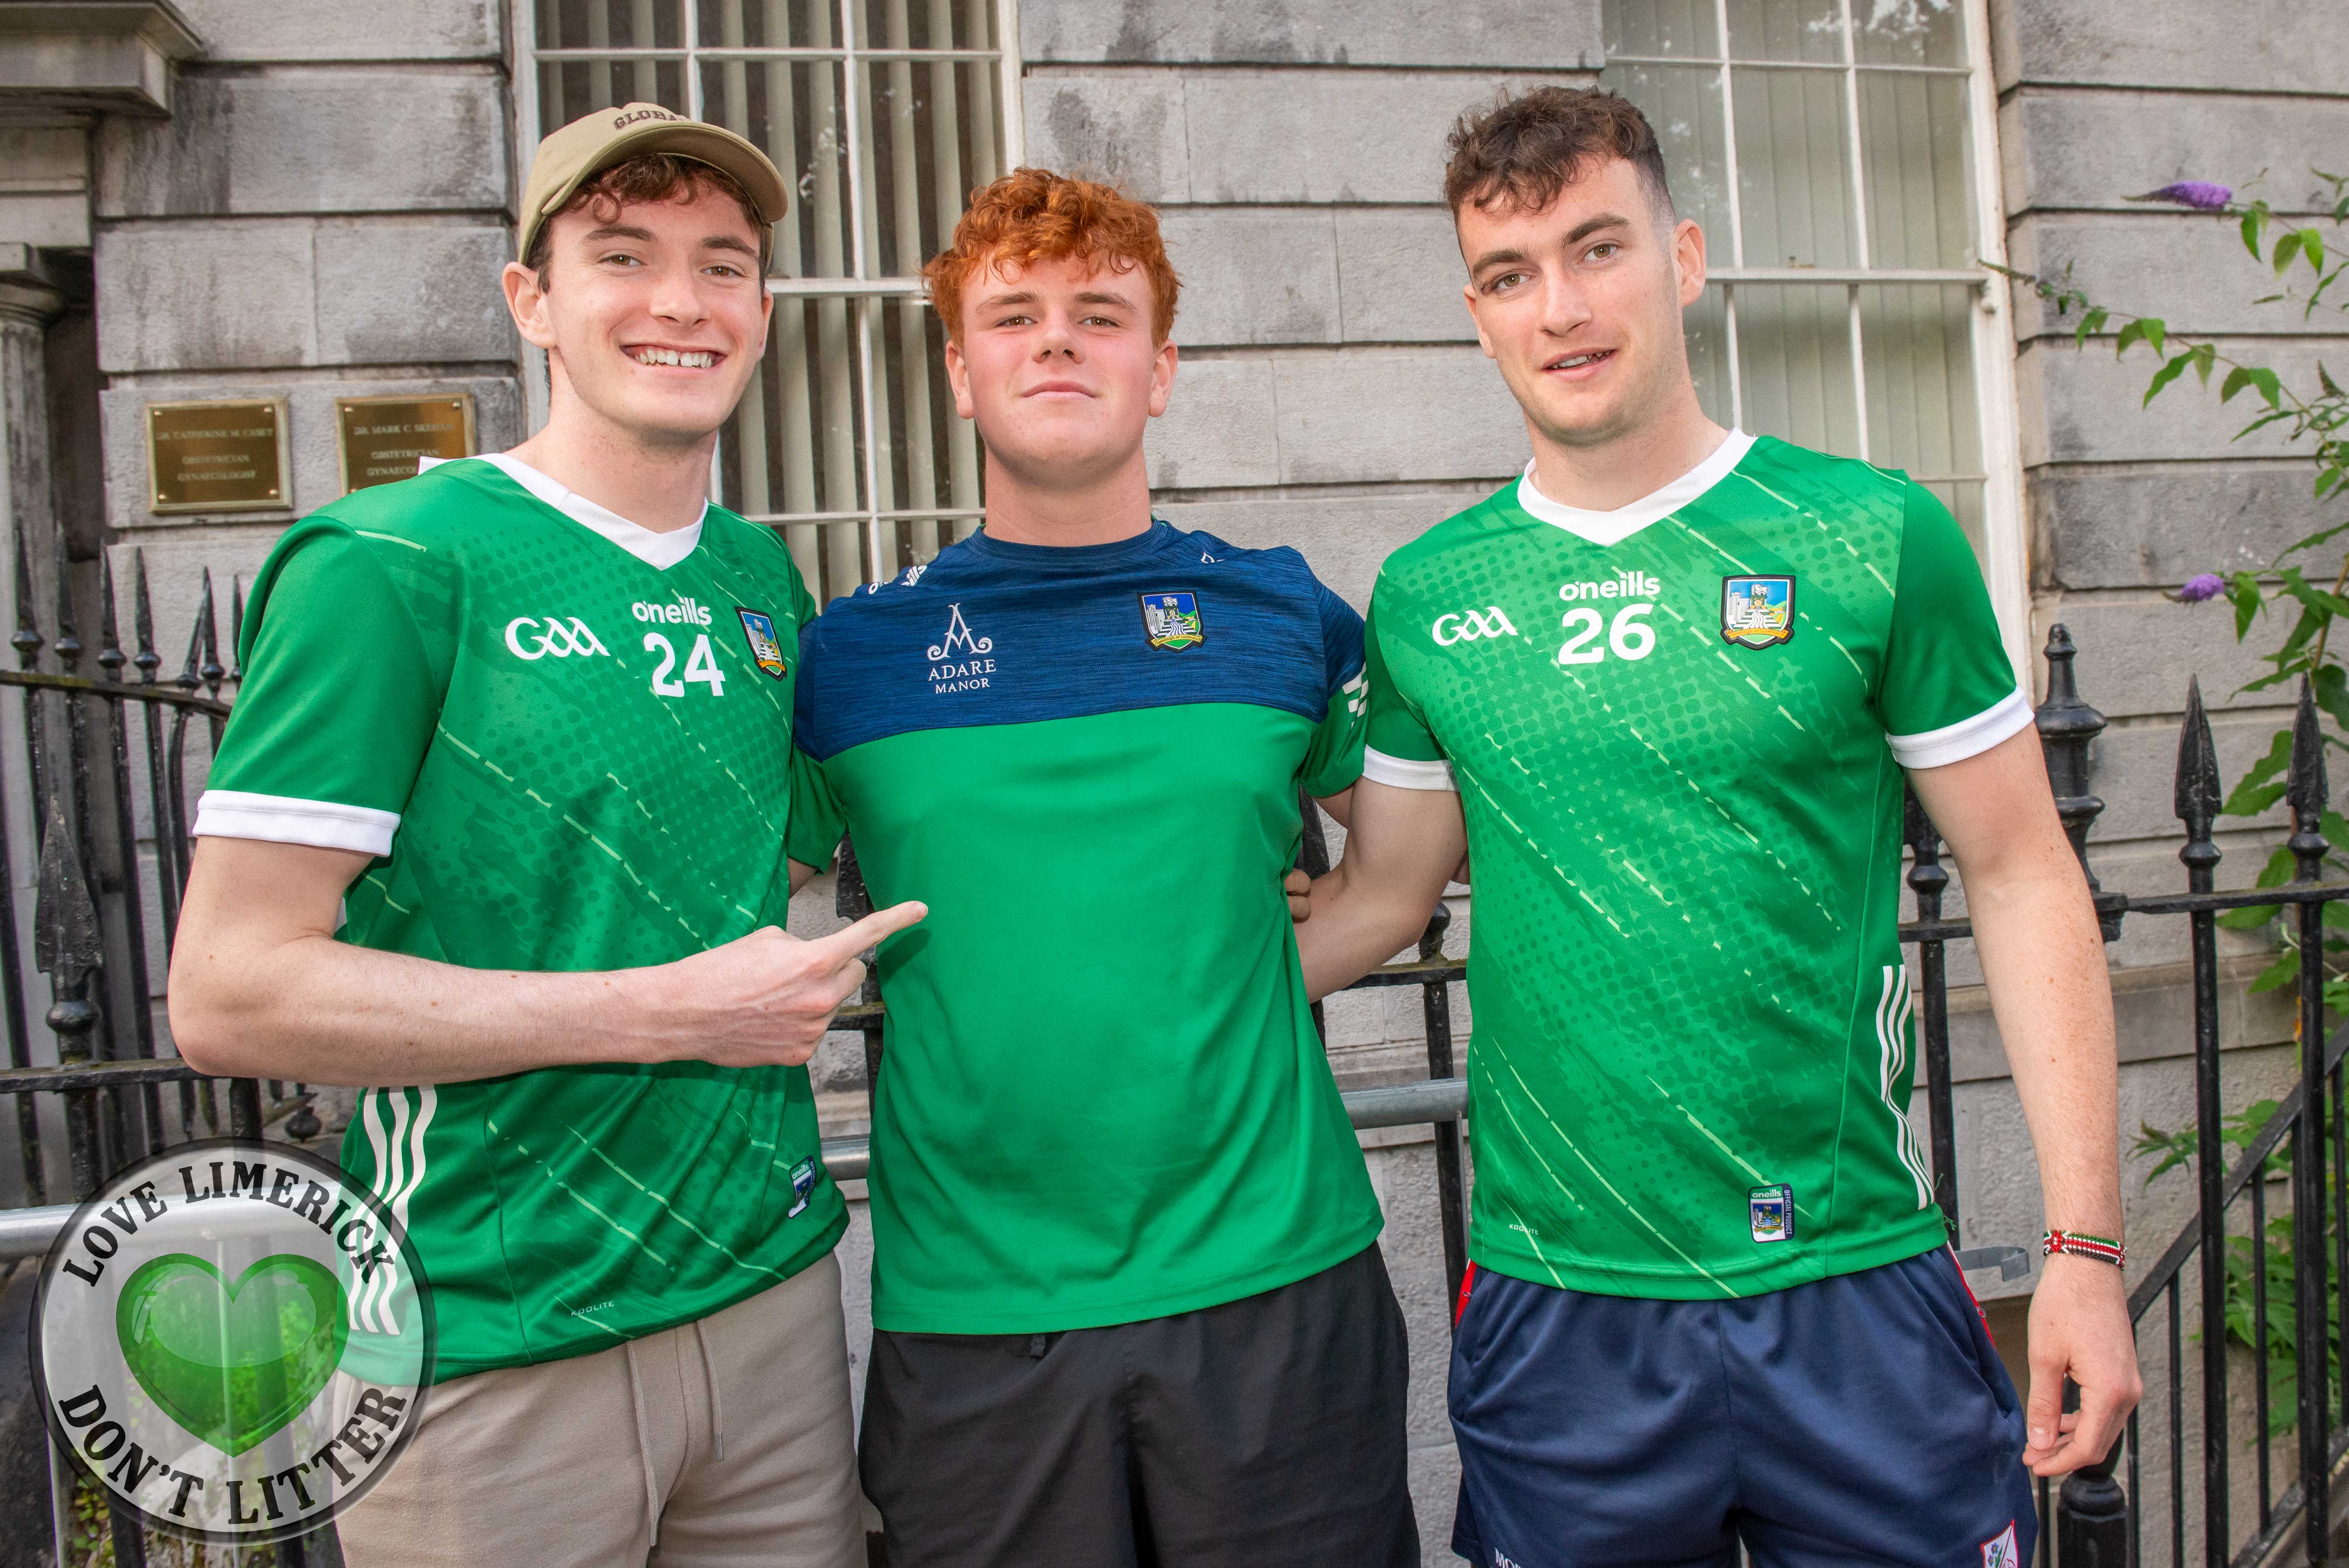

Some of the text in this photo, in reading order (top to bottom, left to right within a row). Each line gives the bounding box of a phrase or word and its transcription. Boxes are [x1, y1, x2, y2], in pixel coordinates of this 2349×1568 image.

[613, 110, 683, 130] GLOBA
[371, 424, 401, 434] MARK
[371, 449, 440, 459] OBSTETRICIAN
[366, 465, 418, 476] GYNAECOL
[1432, 606, 1519, 646] GAA
[1558, 603, 1656, 665] 26
[505, 617, 611, 660] GAA
[643, 632, 726, 697] 24
[928, 659, 996, 681] ADARE
[936, 678, 990, 694] MANOR
[571, 1300, 615, 1316] KOOLITE
